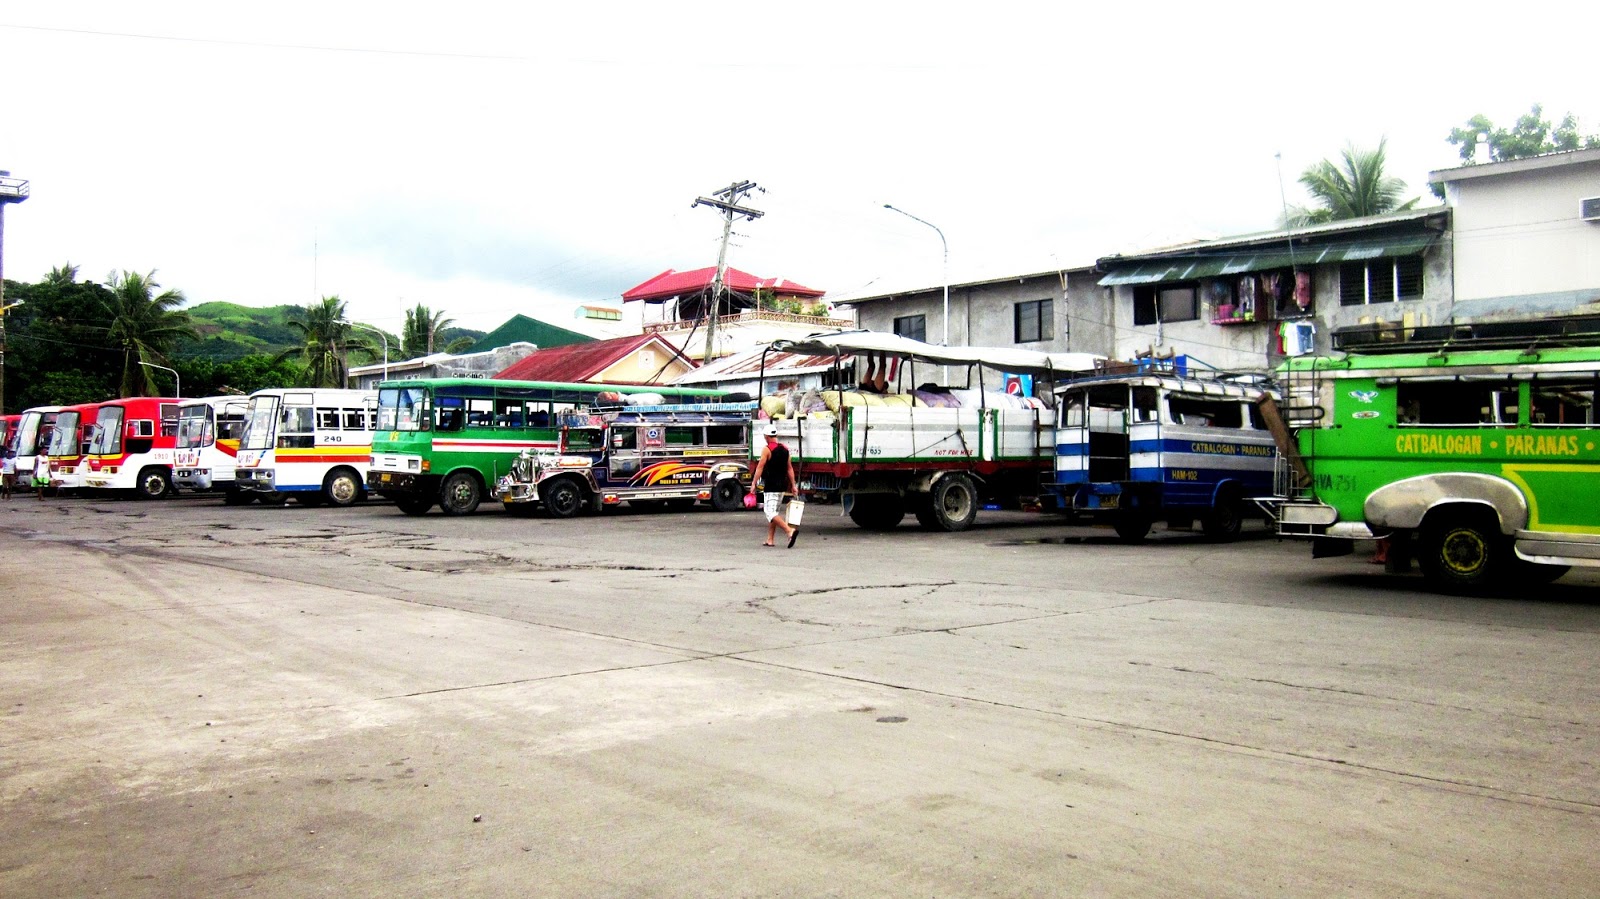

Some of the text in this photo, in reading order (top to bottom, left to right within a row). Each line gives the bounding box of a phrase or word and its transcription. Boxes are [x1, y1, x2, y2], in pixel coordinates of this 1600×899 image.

[1191, 442, 1271, 456] CATBALOGAN PARANAS
[1396, 434, 1578, 456] CATBALOGAN PARANAS
